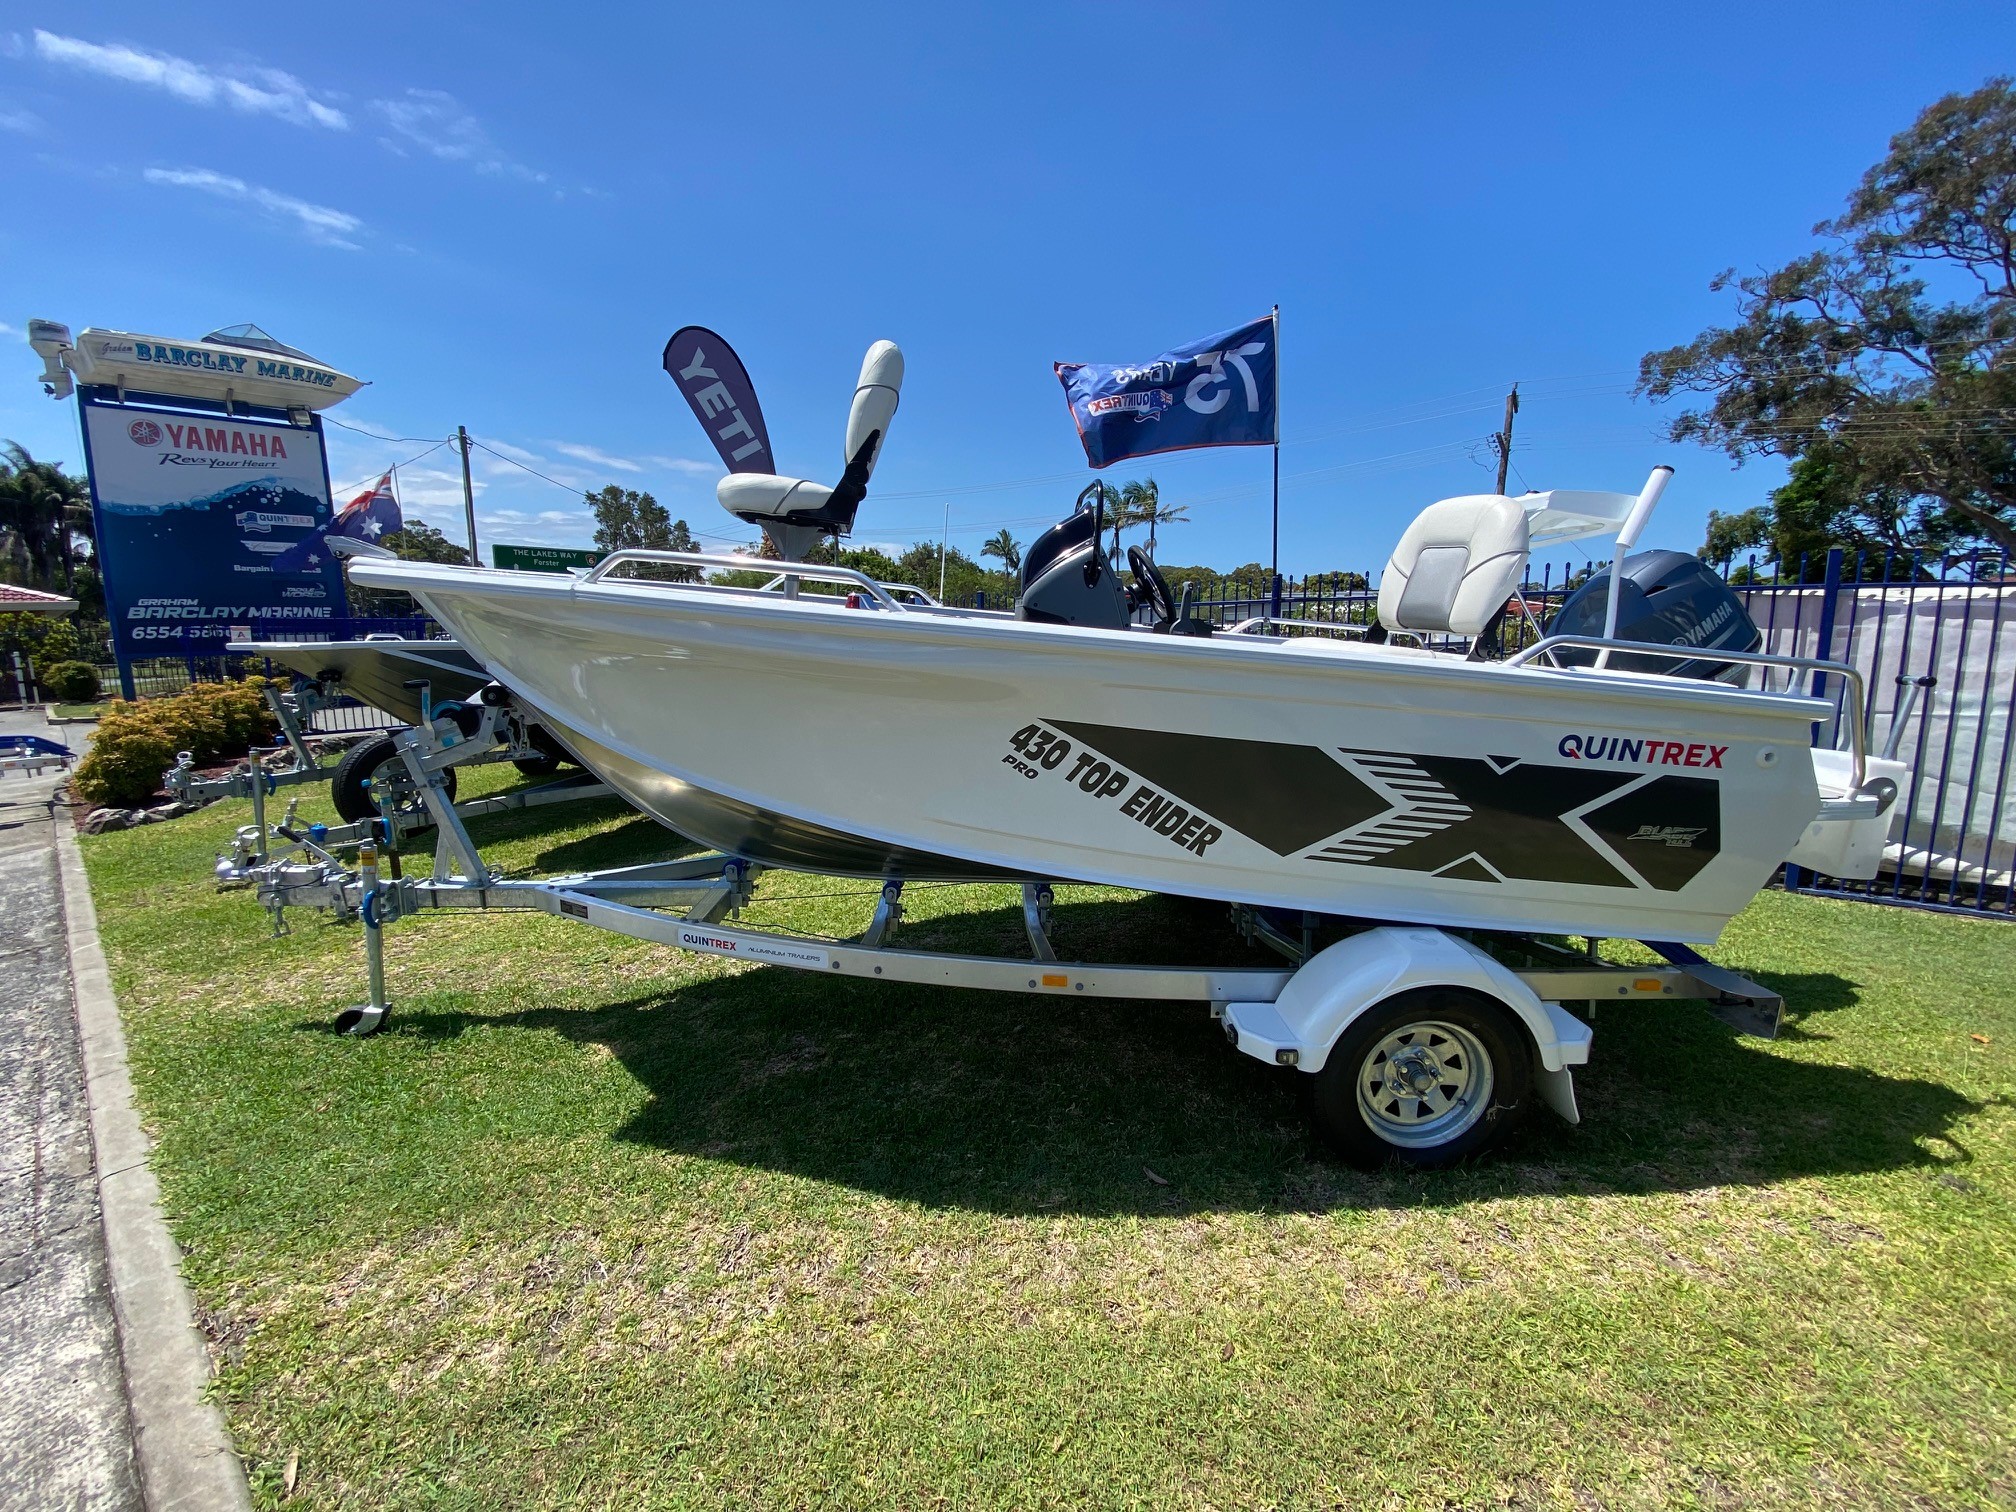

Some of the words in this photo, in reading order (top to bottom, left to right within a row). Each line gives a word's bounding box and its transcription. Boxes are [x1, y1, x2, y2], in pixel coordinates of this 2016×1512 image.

[135, 342, 247, 373] BARCLAY
[257, 360, 338, 387] MARINE
[679, 346, 763, 462] YETI
[165, 423, 287, 459] YAMAHA
[158, 453, 208, 466] Revs
[209, 458, 241, 469] Your
[242, 460, 278, 468] Heart
[531, 550, 558, 558] LAKES
[534, 558, 560, 567] Forster
[233, 564, 270, 573] Bargain
[127, 606, 246, 619] BARCLAY
[1685, 601, 1733, 645] YAMAHA
[132, 626, 183, 640] 6554
[1558, 734, 1729, 769] QUINTREX
[1001, 754, 1039, 780] PRO
[1009, 724, 1072, 770] 430
[1065, 752, 1130, 799] TOP
[1119, 785, 1223, 858] ENDER
[683, 933, 736, 951] QUINTREX
[748, 947, 785, 956] ALUMINIUM
[787, 952, 820, 962] TRAILERS
